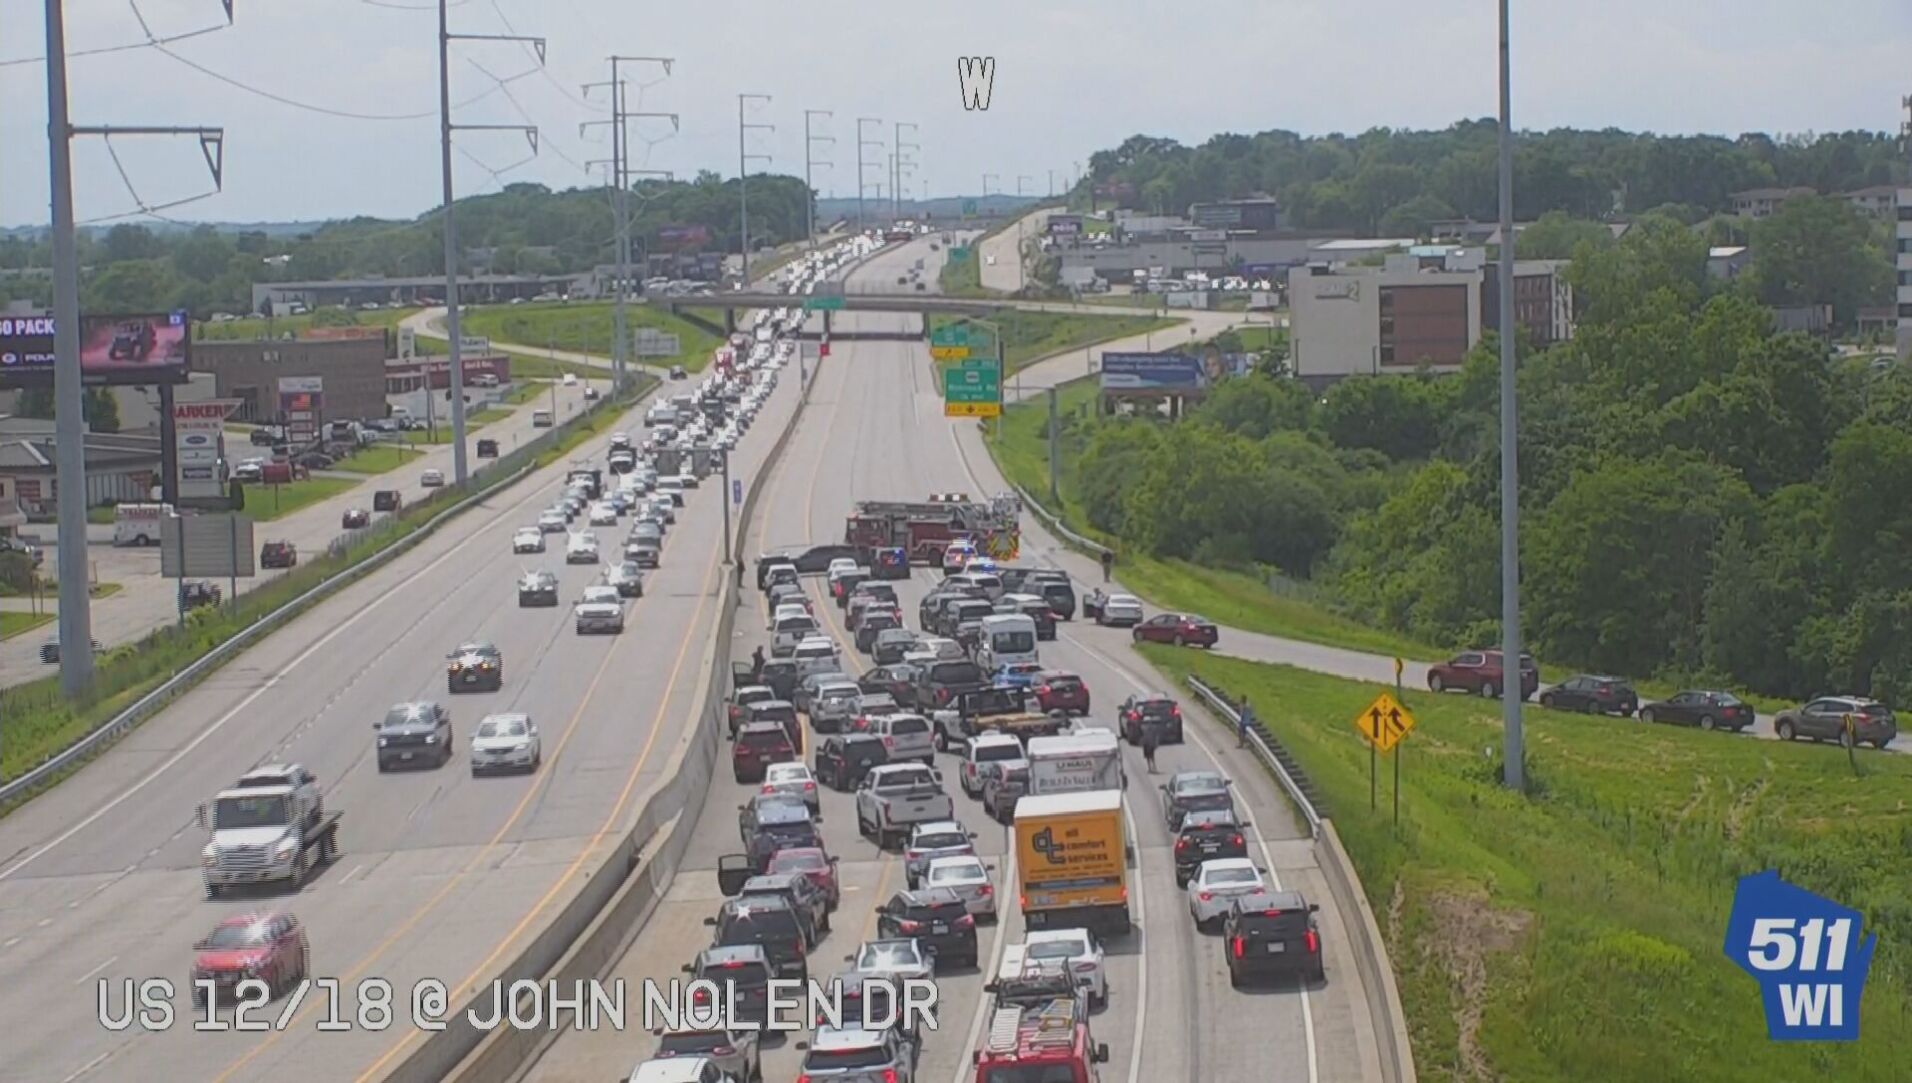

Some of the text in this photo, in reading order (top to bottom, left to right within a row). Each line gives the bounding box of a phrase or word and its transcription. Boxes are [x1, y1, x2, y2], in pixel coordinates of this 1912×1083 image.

[15, 318, 55, 335] PACK
[1066, 839, 1106, 850] comfort
[1068, 853, 1108, 864] services
